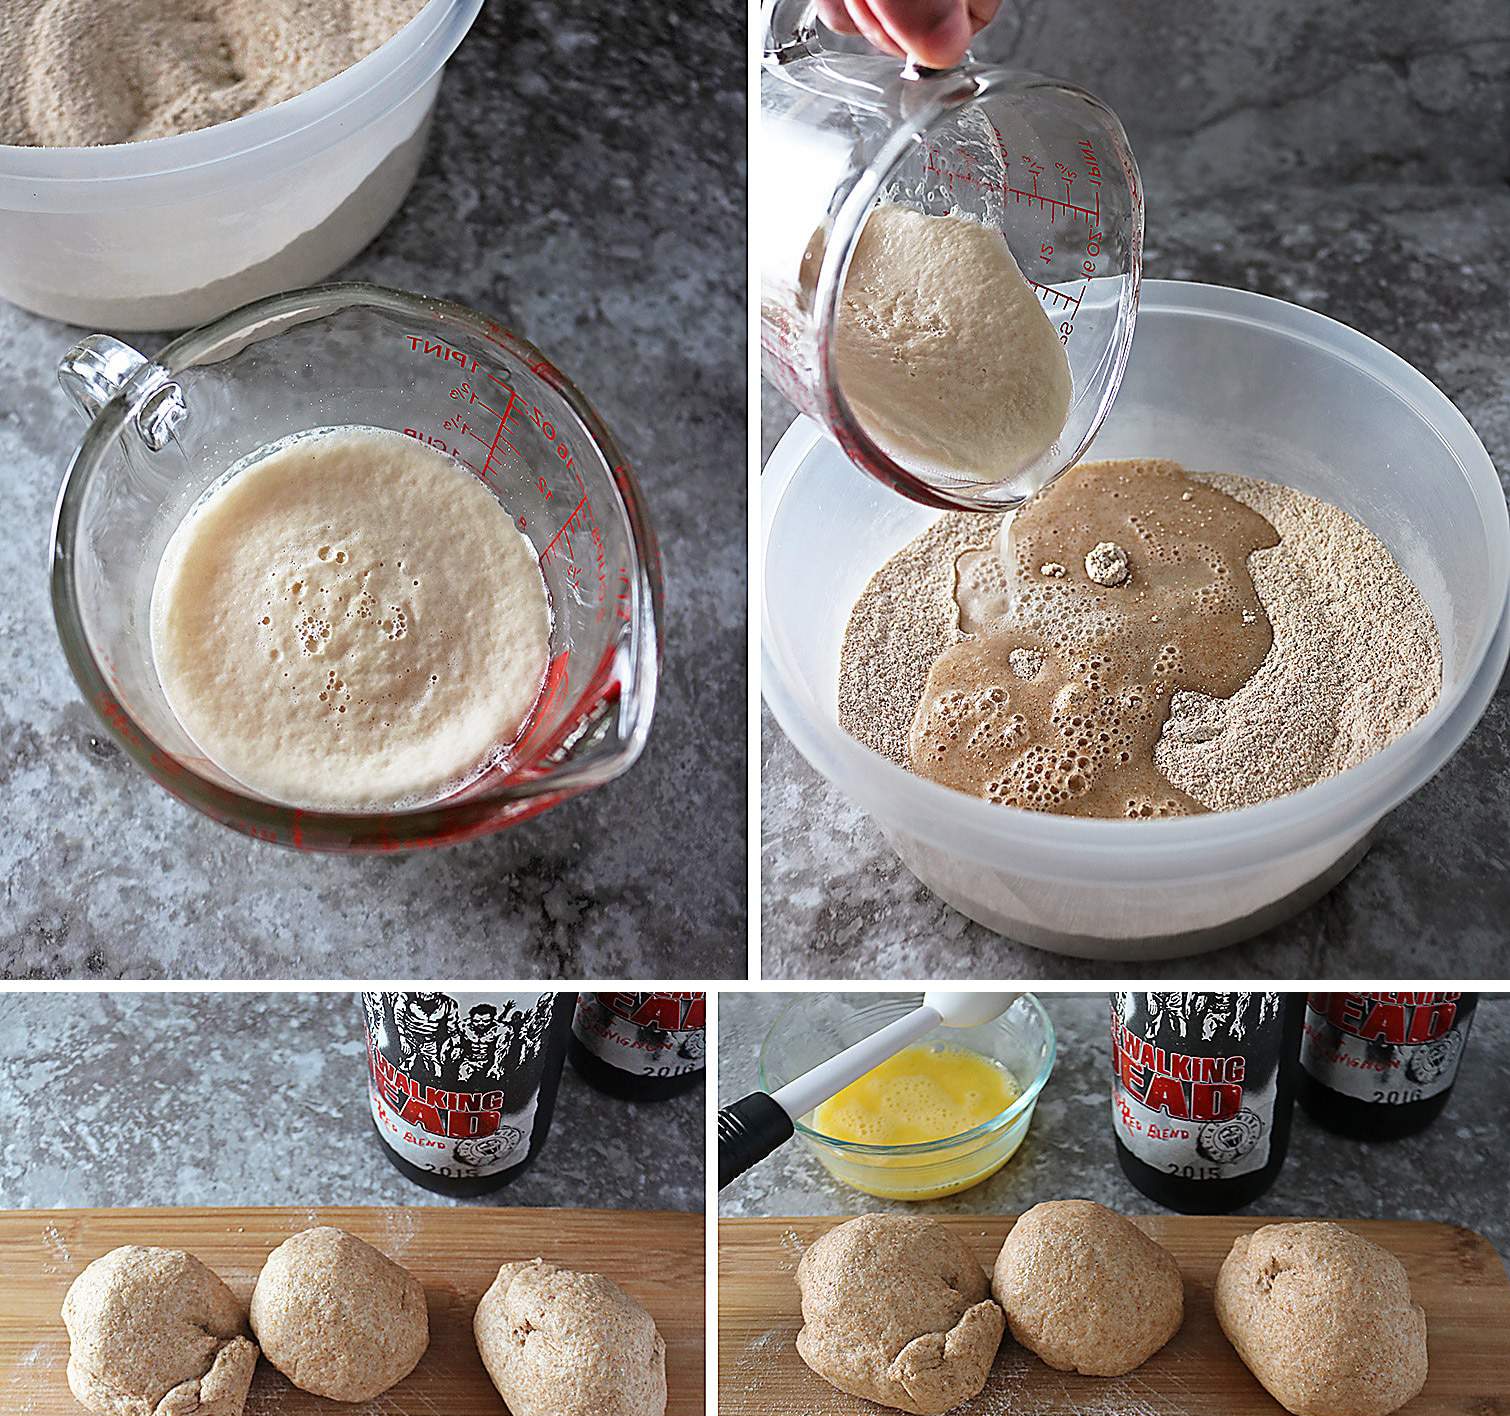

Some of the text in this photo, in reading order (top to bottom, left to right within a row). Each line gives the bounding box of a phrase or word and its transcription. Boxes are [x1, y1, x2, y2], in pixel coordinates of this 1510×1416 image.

[373, 1047, 505, 1113] WALKING
[1121, 1024, 1246, 1084] WALKING
[370, 1062, 502, 1140] EAD
[1147, 1123, 1191, 1141] BLEND
[1167, 1163, 1221, 1180] 2015
